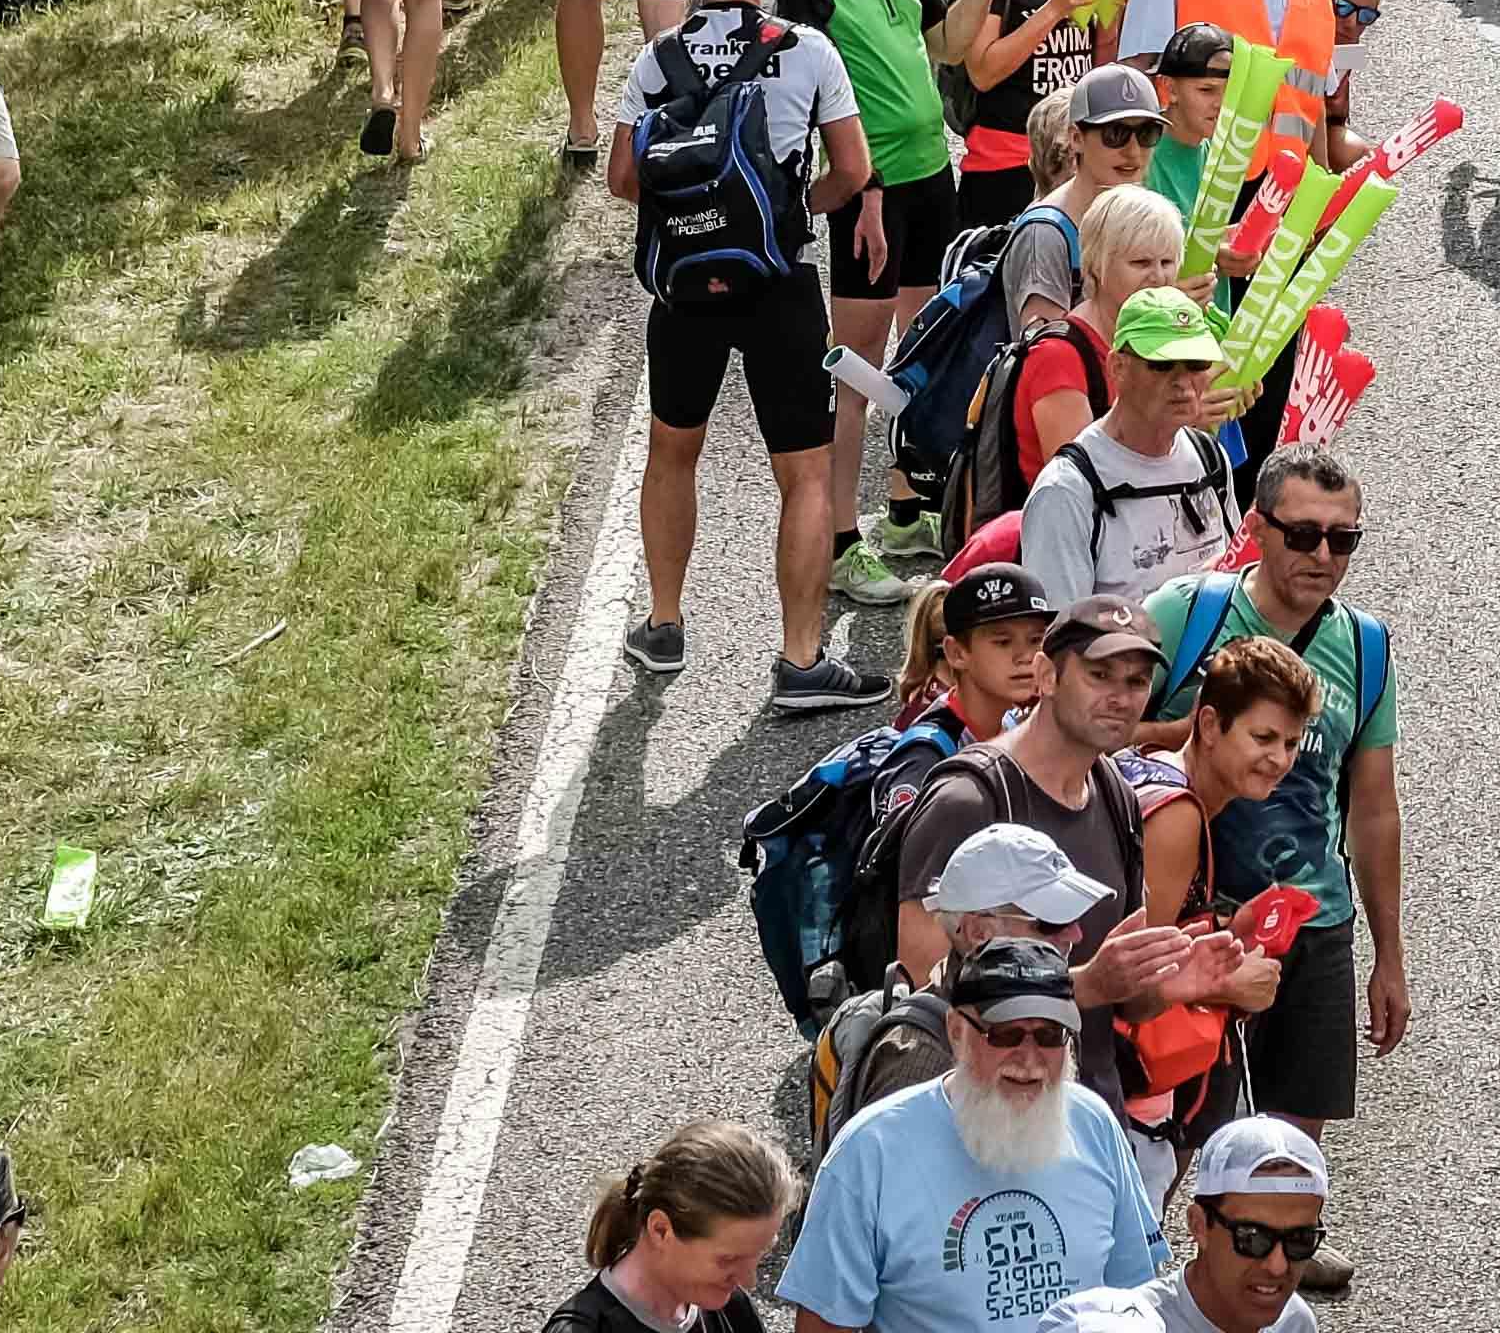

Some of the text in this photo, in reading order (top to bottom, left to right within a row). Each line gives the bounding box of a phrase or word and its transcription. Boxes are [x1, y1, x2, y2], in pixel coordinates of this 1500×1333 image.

[994, 1211, 1026, 1222] YEARS
[983, 1222, 1036, 1267] 60
[986, 1262, 1062, 1294] 21900
